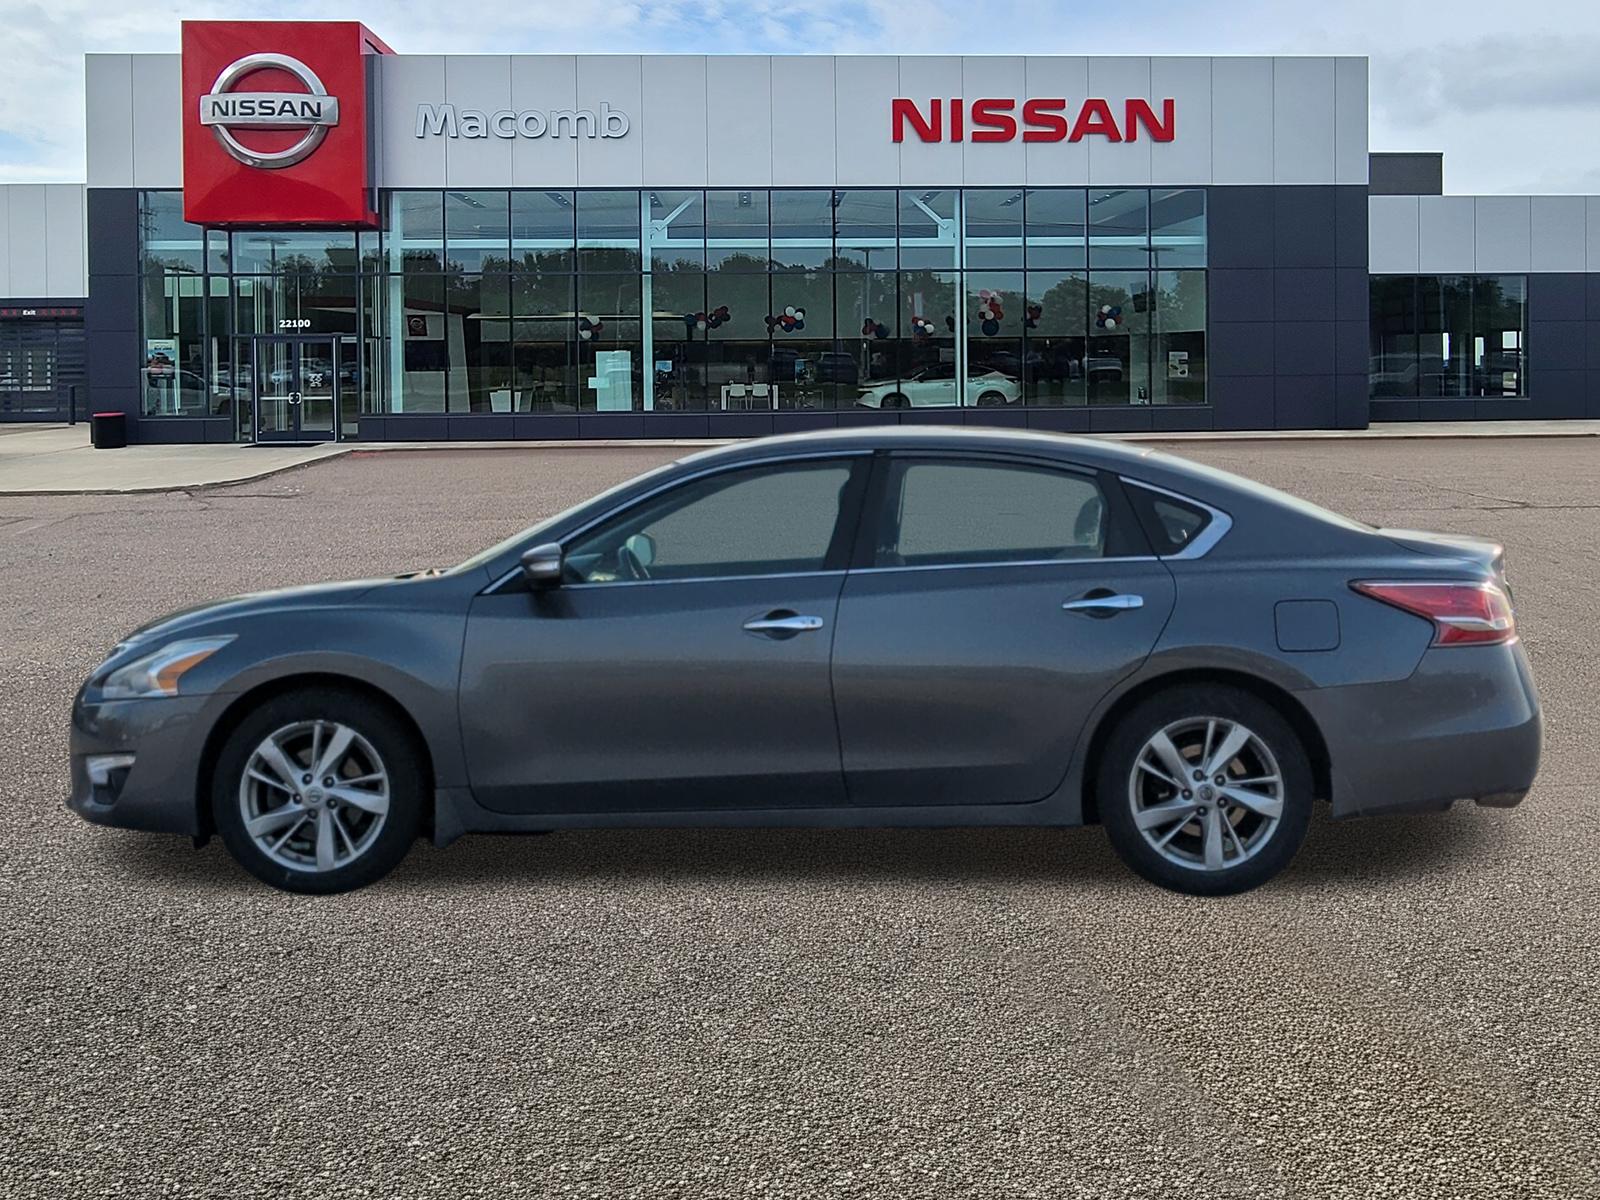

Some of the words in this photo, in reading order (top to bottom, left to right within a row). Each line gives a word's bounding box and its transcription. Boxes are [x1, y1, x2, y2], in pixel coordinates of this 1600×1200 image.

[212, 100, 322, 118] NISSAN
[415, 102, 630, 139] Macomb
[892, 98, 1175, 143] NISSAN
[279, 319, 311, 328] 22100
